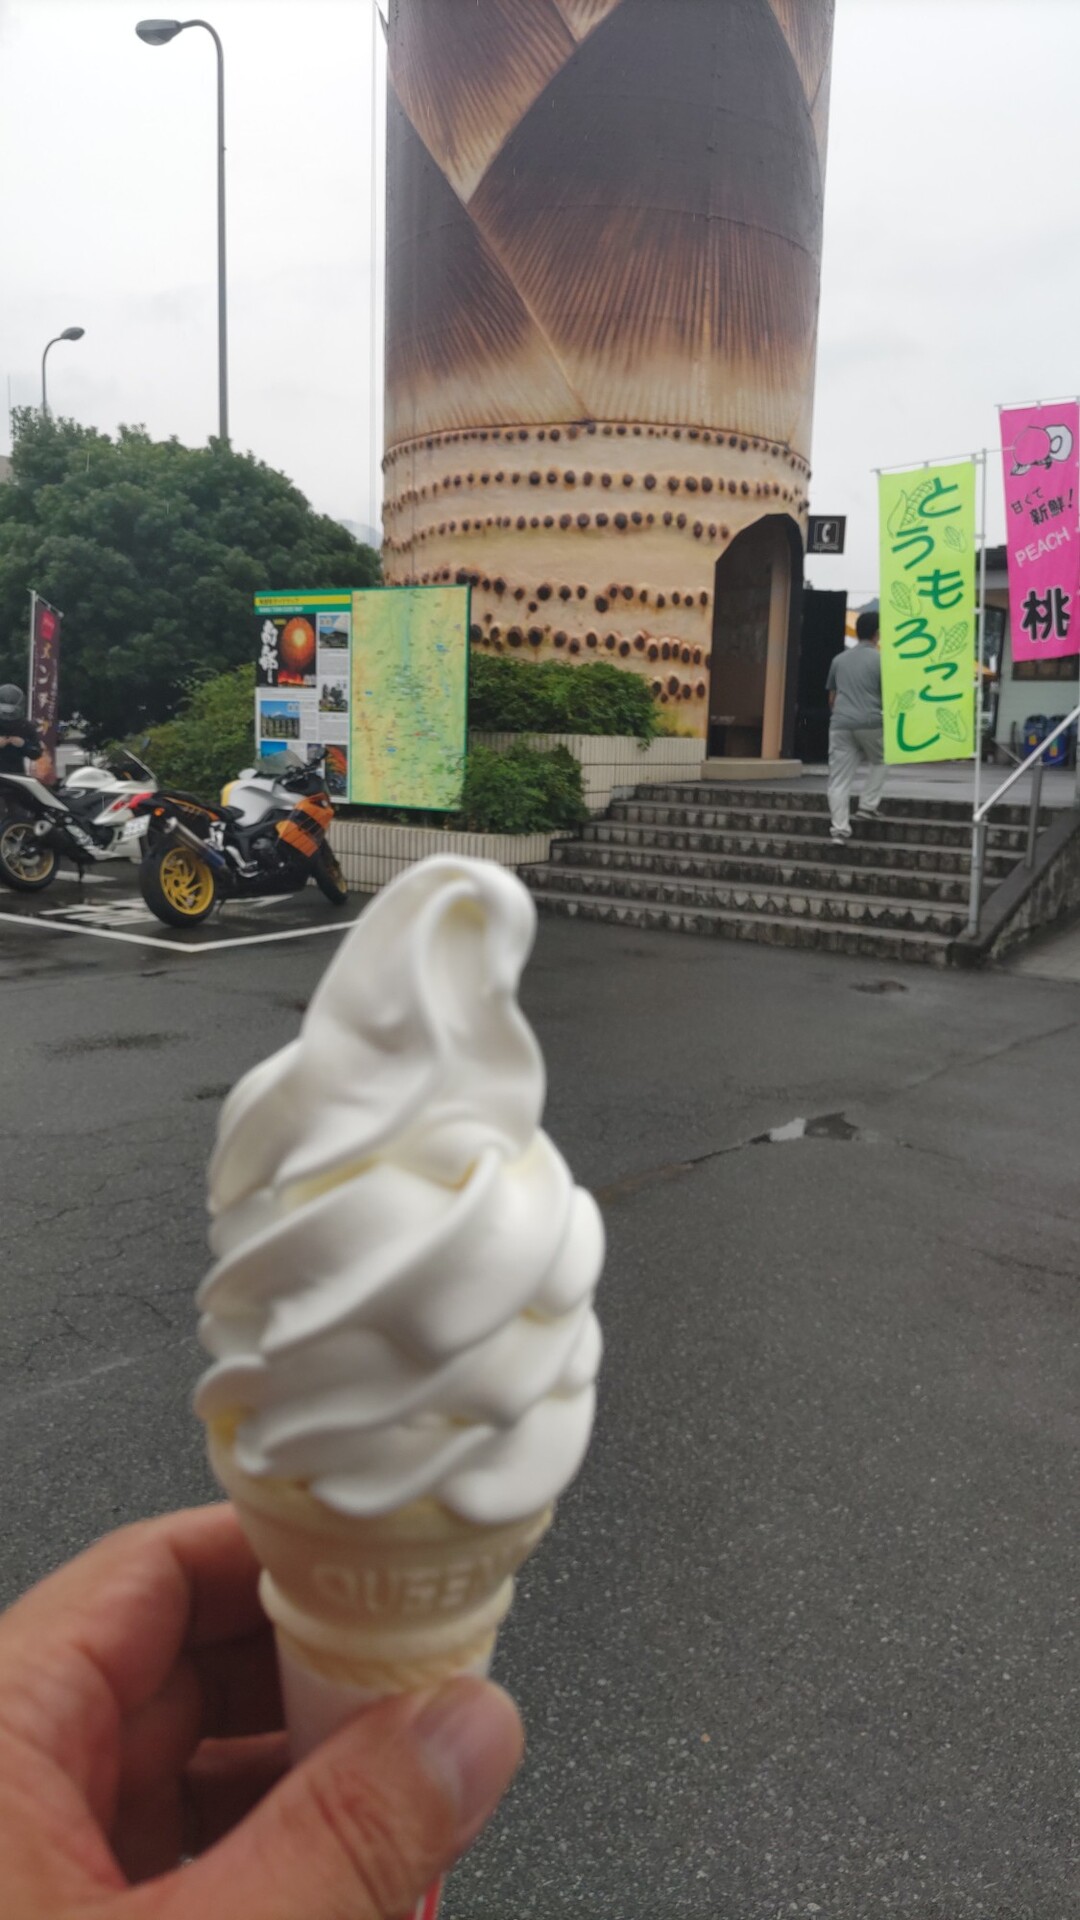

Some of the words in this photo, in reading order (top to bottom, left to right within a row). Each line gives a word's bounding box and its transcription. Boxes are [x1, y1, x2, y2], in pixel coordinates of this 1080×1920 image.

[1015, 526, 1071, 568] PEACH
[891, 477, 963, 752] とうもろこし
[1022, 587, 1071, 641] 桃
